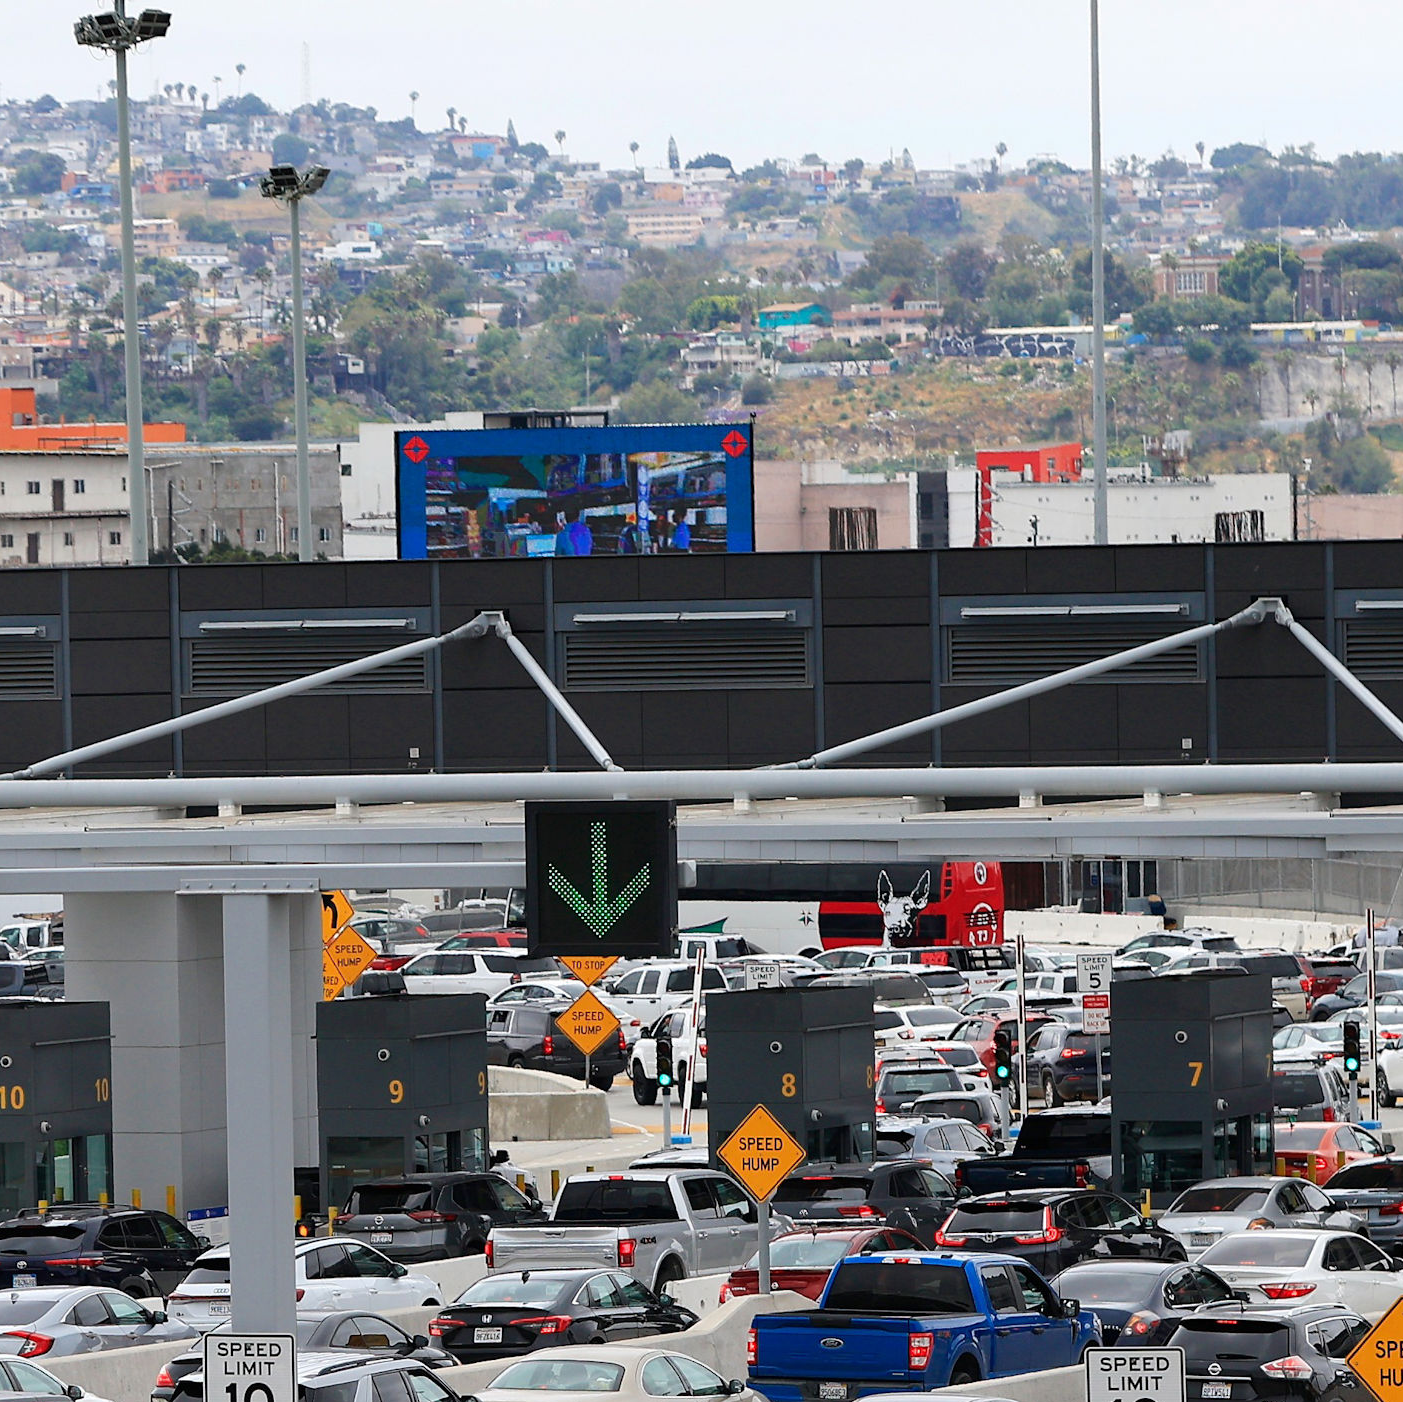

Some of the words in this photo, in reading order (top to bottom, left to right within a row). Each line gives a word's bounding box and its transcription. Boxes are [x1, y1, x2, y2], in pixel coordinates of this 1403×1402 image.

[335, 944, 363, 954] SPEED
[337, 957, 362, 968] HUMP
[570, 961, 580, 970] TO
[582, 960, 603, 970] STOP
[1089, 973, 1101, 988] 5
[571, 1010, 604, 1022] SPEED
[574, 1024, 602, 1036] HUMP
[866, 1065, 873, 1089] 8
[1188, 1062, 1203, 1086] 7
[95, 1079, 109, 1102] 10
[478, 1072, 485, 1095] 9
[781, 1073, 796, 1097] 8
[389, 1080, 404, 1103] 9
[739, 1137, 783, 1151] SPEED
[742, 1157, 780, 1171] HUMP
[217, 1343, 281, 1357] SPEED
[224, 1362, 275, 1375] LIMIT
[1099, 1357, 1170, 1372] SPEED
[1106, 1376, 1162, 1391] LIMIT
